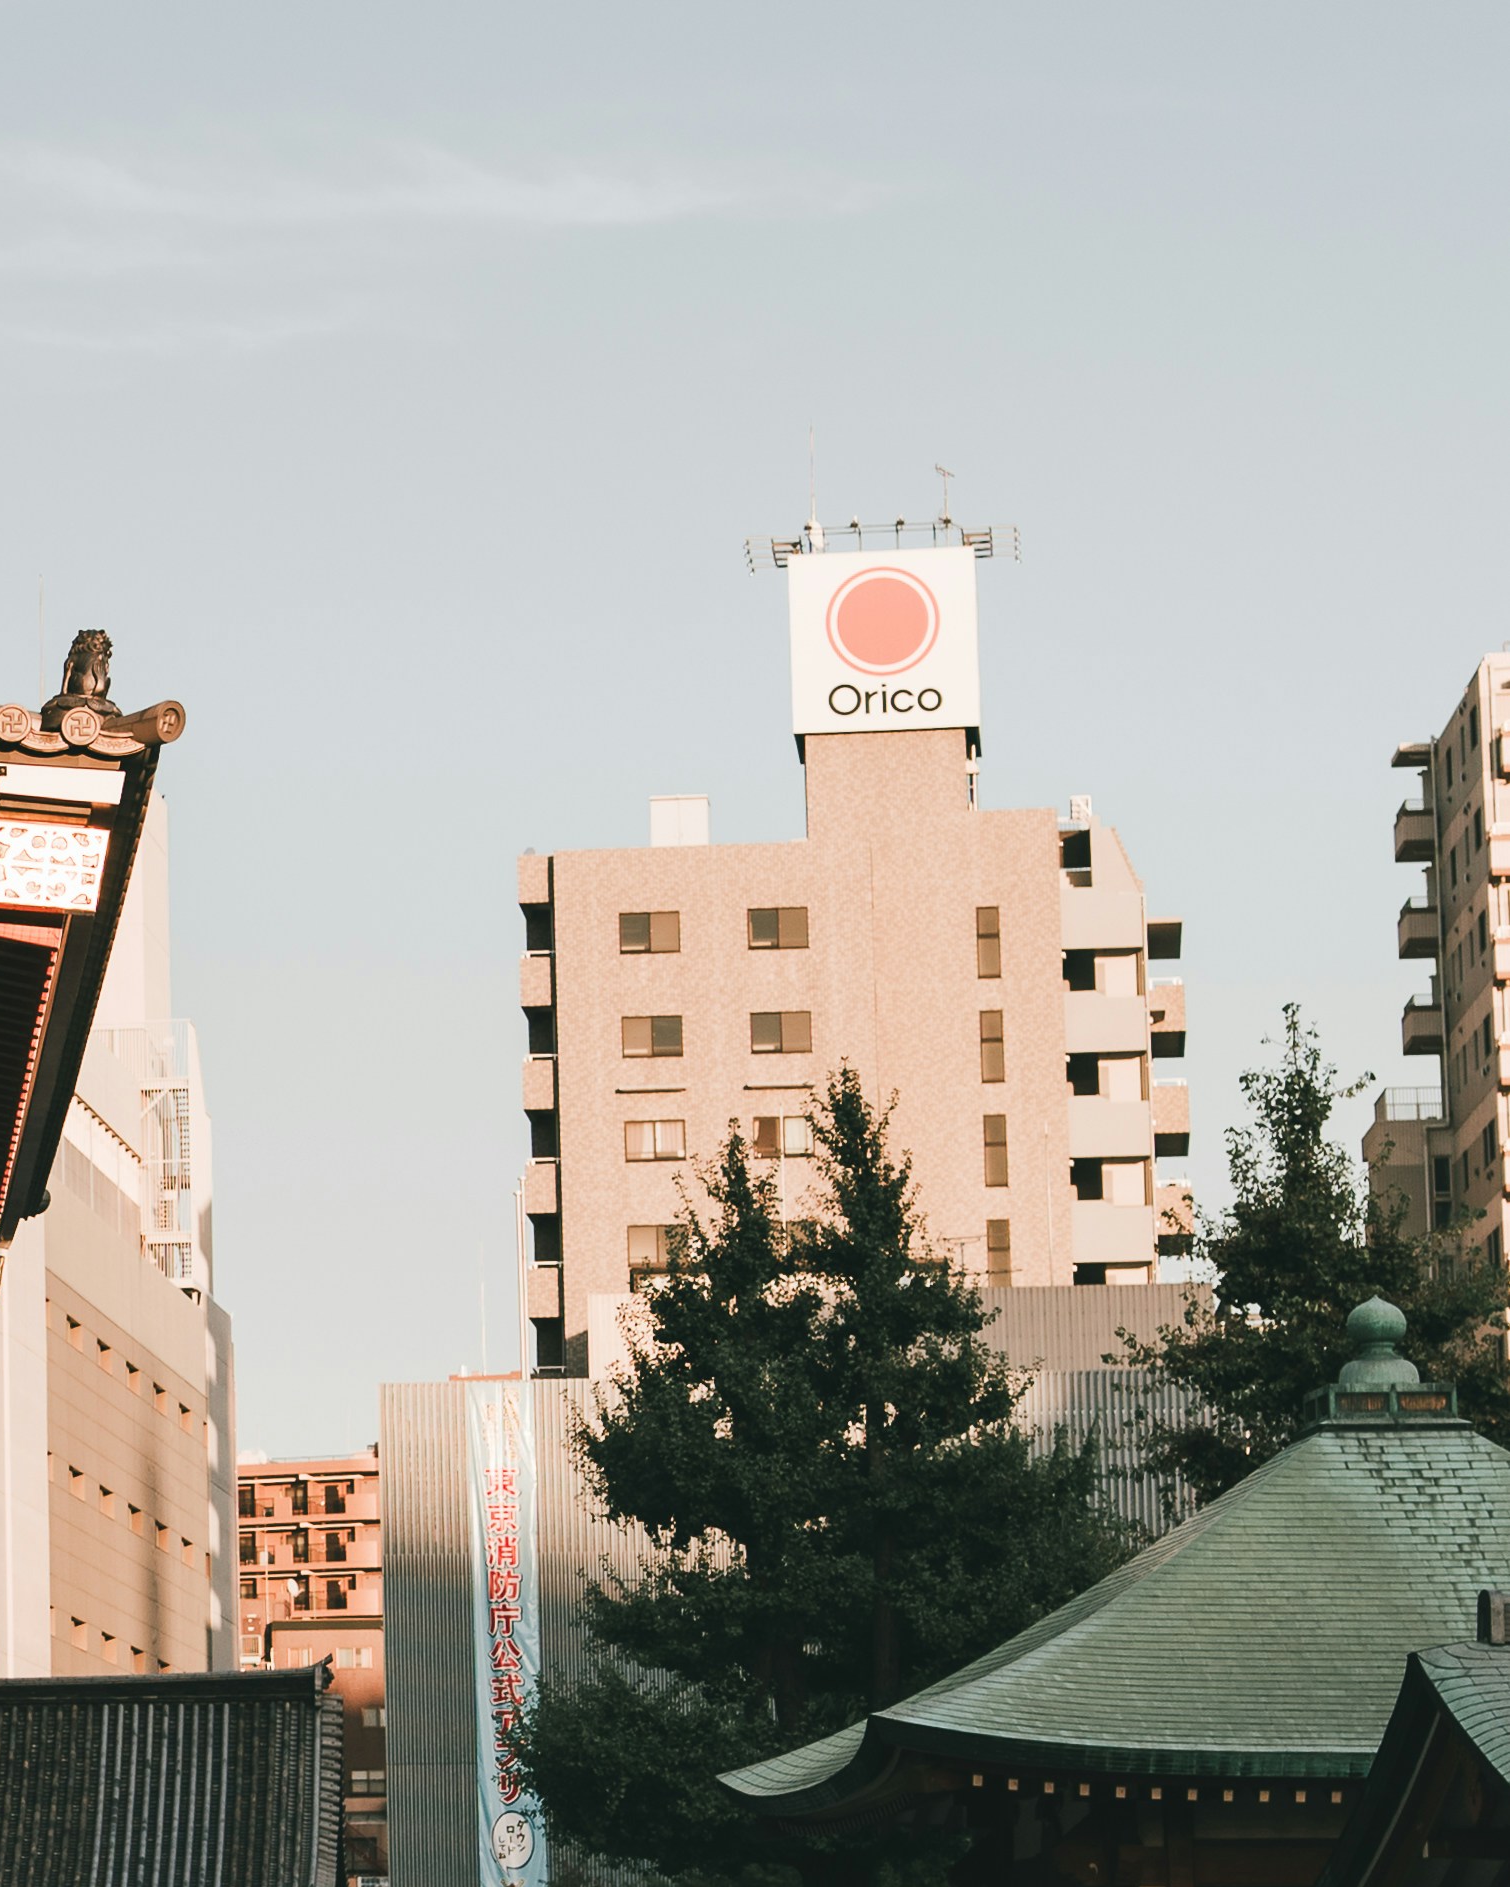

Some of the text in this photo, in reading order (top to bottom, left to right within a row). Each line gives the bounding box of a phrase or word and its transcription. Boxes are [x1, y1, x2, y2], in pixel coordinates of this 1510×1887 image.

[829, 684, 942, 715] Orico
[498, 1835, 506, 1859] してね
[506, 1825, 516, 1855] ロード
